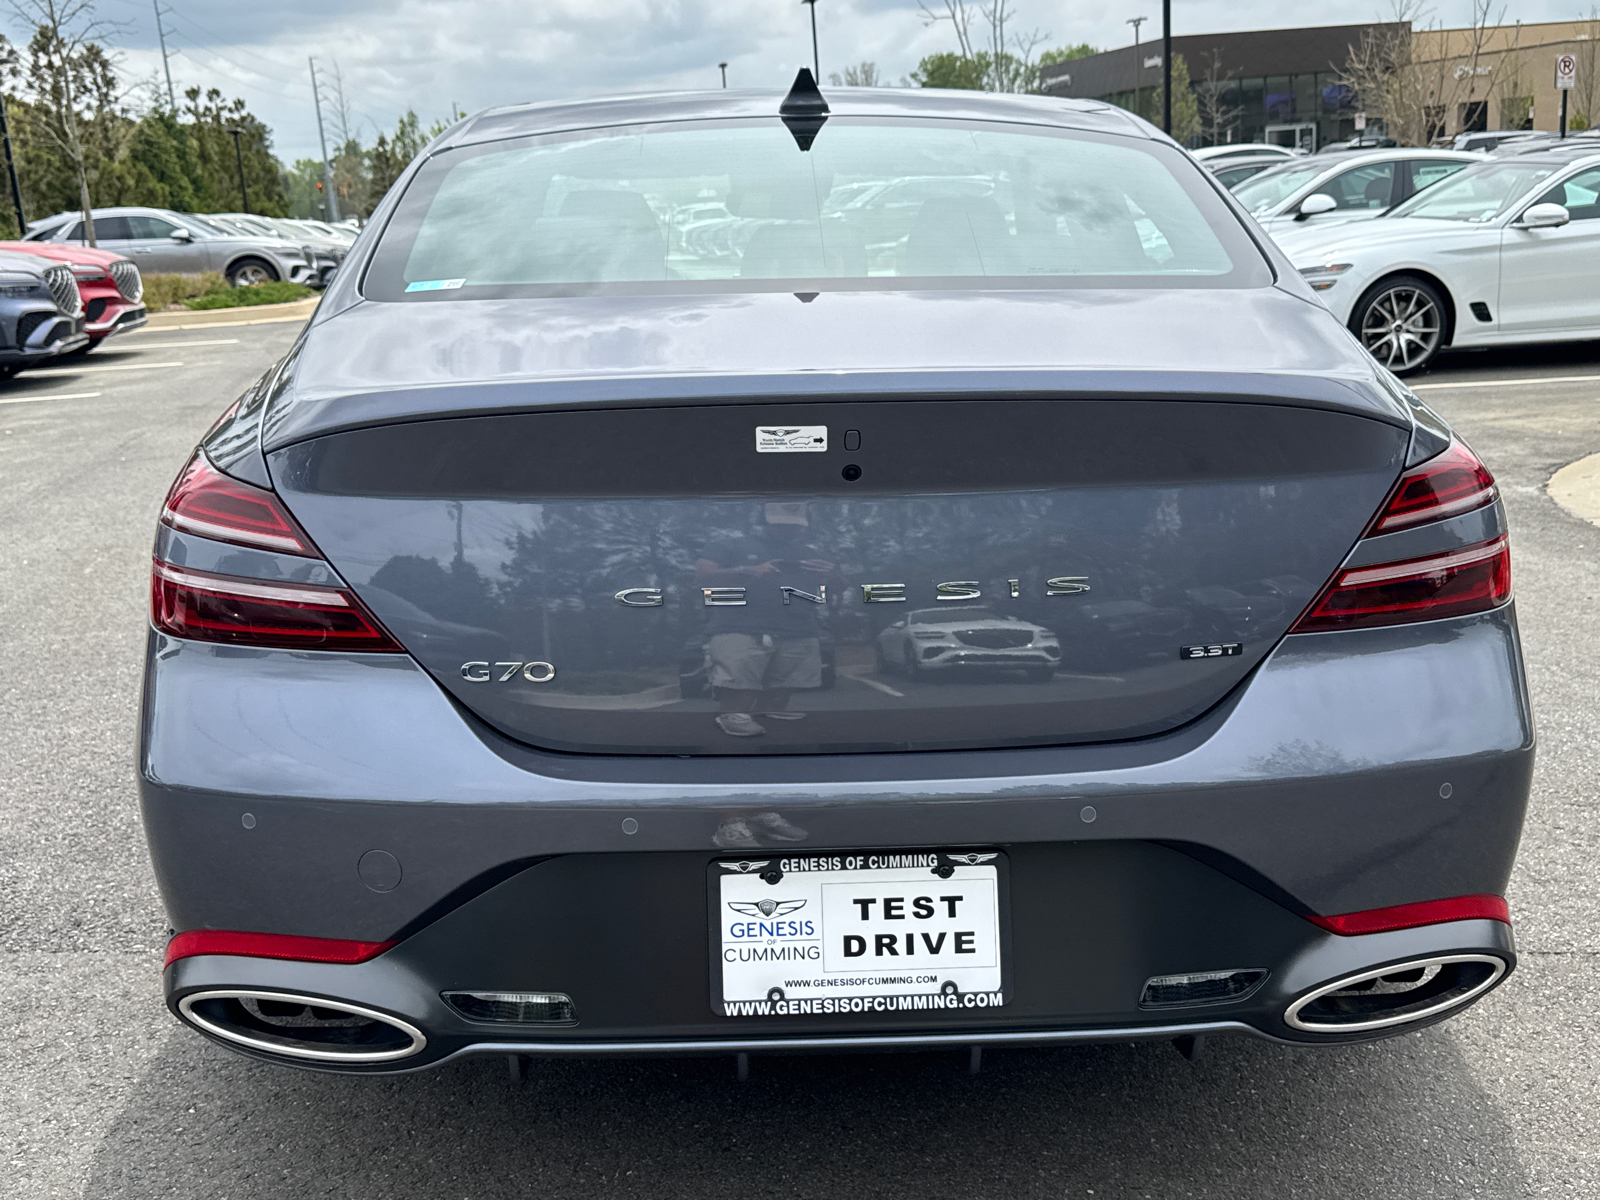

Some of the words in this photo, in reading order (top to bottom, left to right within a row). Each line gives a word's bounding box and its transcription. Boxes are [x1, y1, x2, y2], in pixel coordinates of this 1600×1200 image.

[614, 576, 1091, 607] GENESIS
[1189, 643, 1238, 658] 3.3T
[460, 661, 556, 683] G70
[779, 856, 842, 873] GENESIS
[845, 855, 865, 870] OF
[869, 853, 938, 869] CUMMING
[852, 895, 964, 921] TEST
[729, 920, 815, 938] GENESIS
[723, 945, 821, 963] CUMMING
[843, 931, 976, 958] DRIVE
[784, 975, 938, 989] WWW.GENESISOFCUMMING.COM
[723, 993, 1004, 1017] WWW.GENESISOFCUMMING.COM
